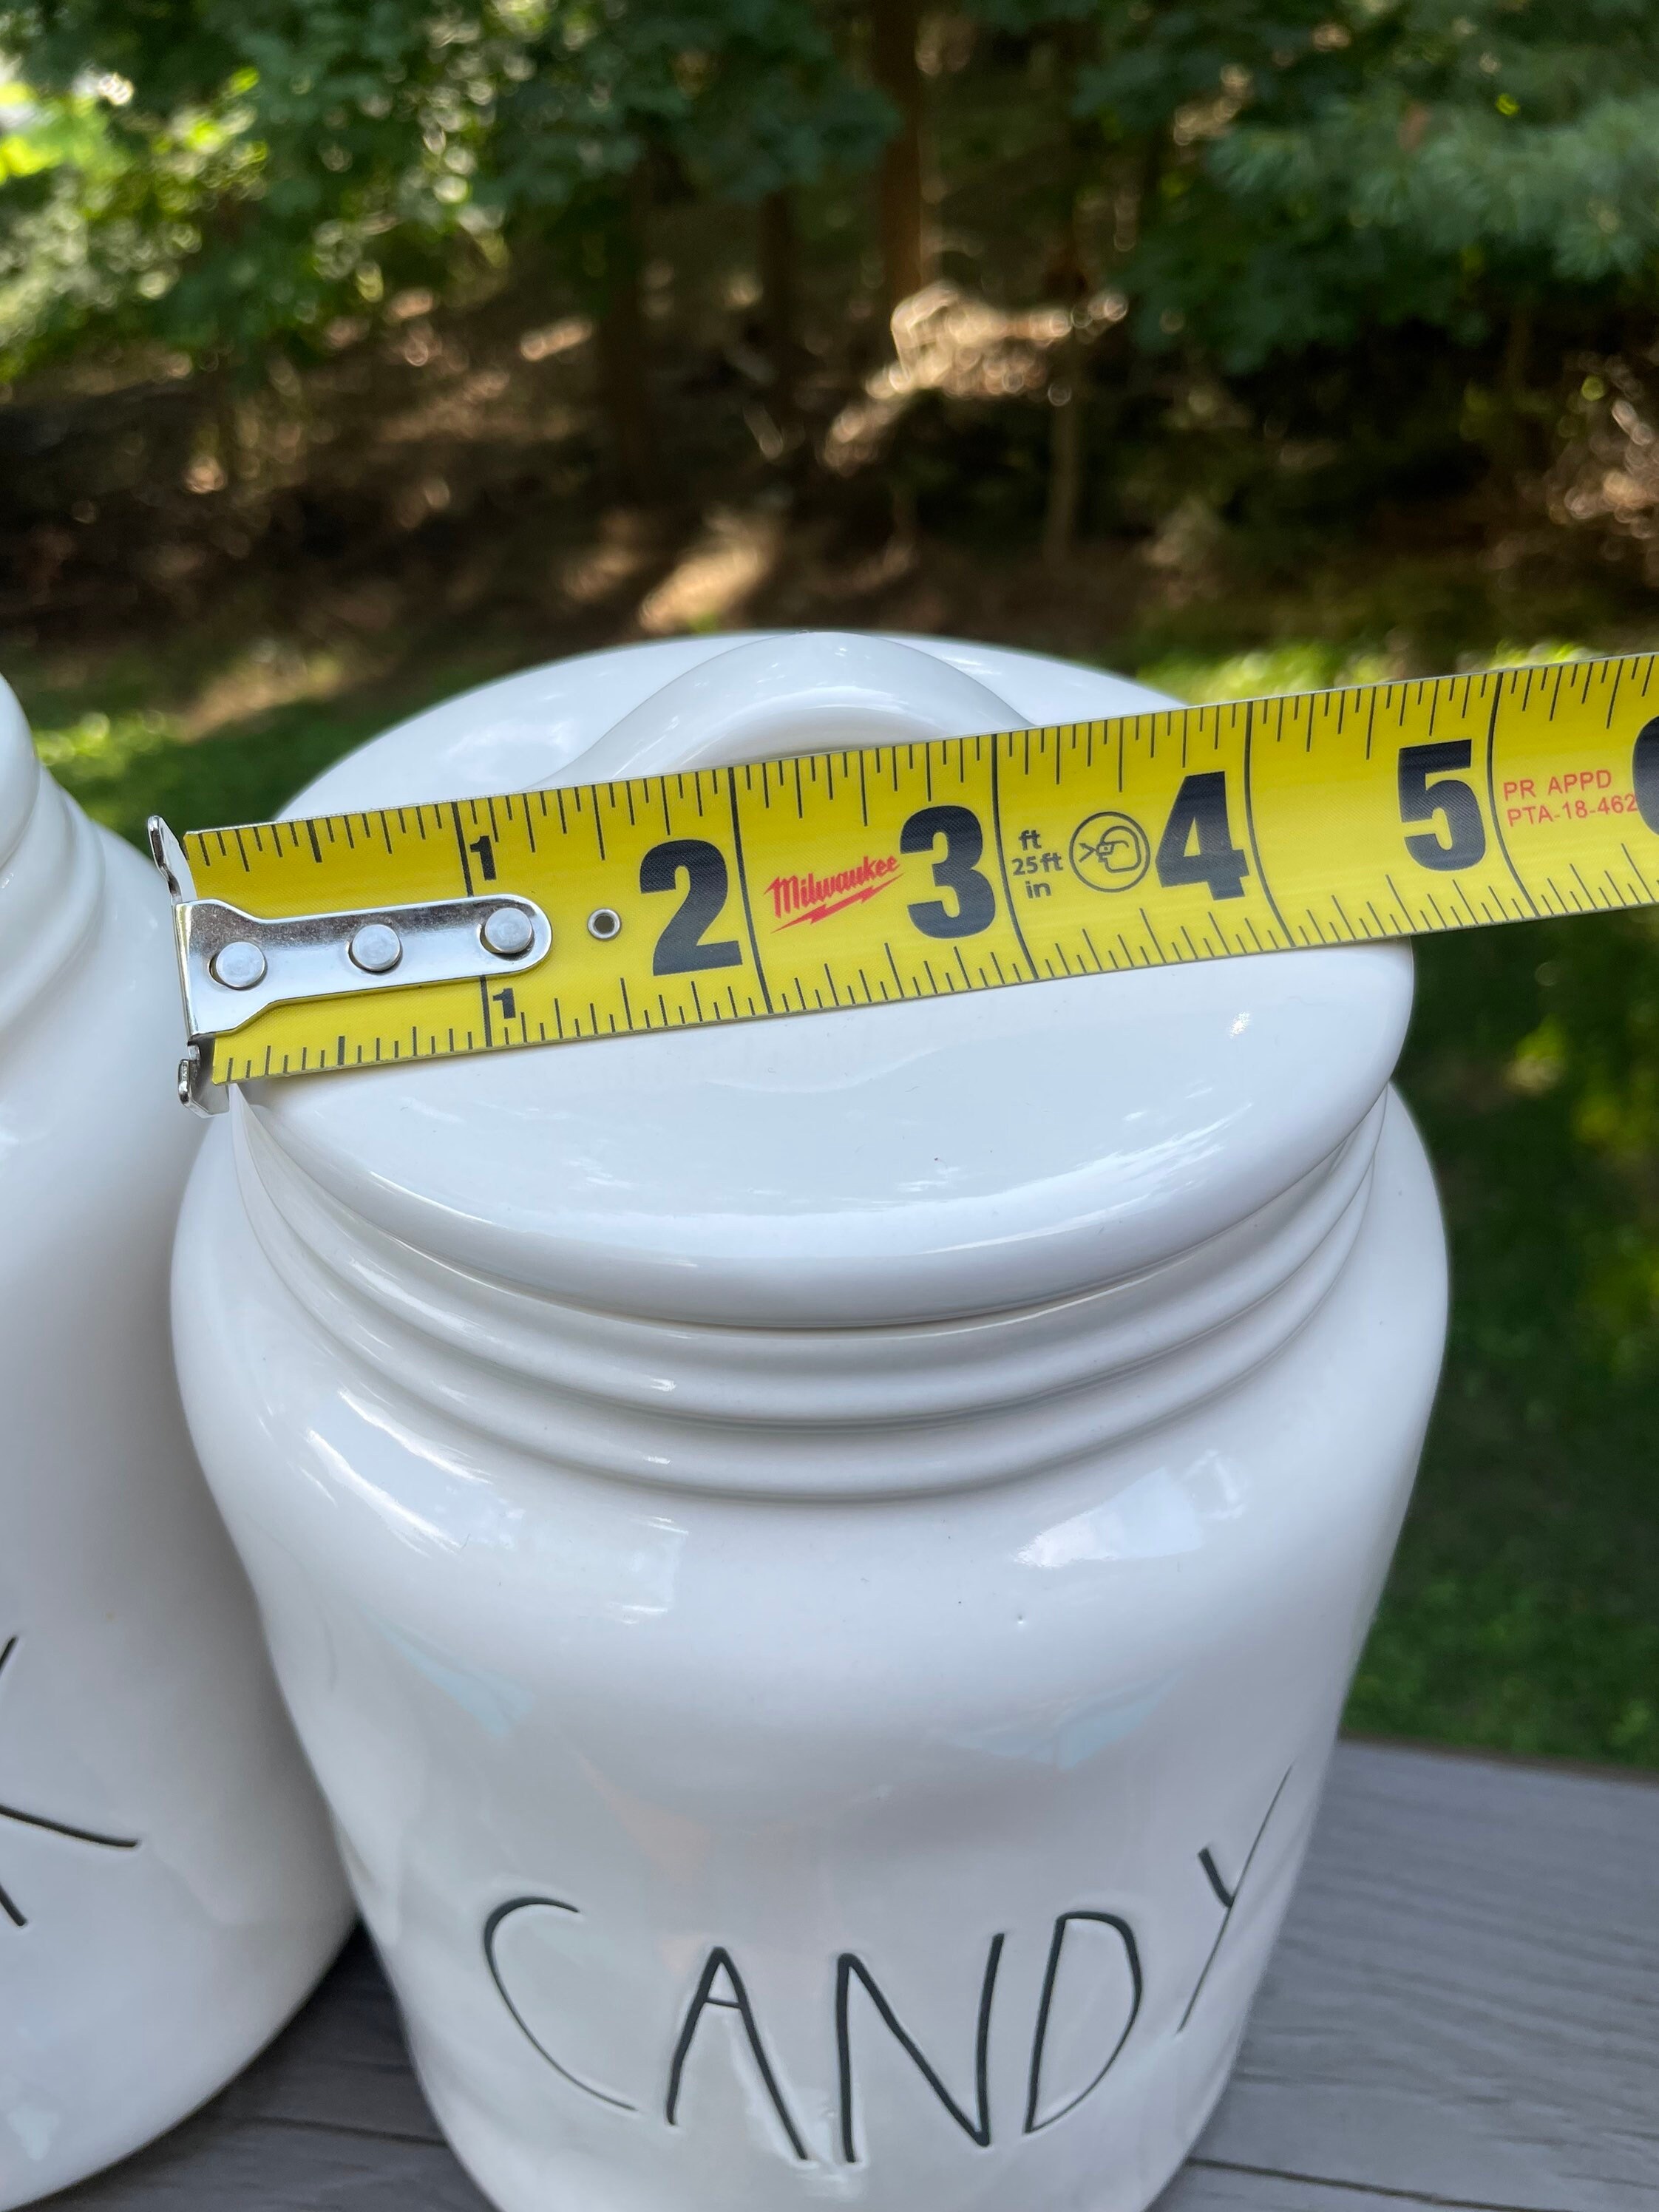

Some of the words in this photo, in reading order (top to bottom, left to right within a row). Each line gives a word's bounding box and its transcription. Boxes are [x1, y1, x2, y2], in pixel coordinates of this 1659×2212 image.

[1398, 739, 1487, 872] 5
[1504, 781, 1536, 800] PR
[1547, 769, 1612, 795] APPD
[470, 835, 496, 881] 1
[1018, 830, 1042, 851] ft
[1156, 771, 1249, 900] 4
[764, 855, 902, 920] Milwaukee
[900, 805, 995, 938] 3
[1025, 881, 1051, 899] in
[639, 839, 742, 976] 2
[492, 988, 517, 1019] 1
[482, 1763, 1295, 2164] CANDY
